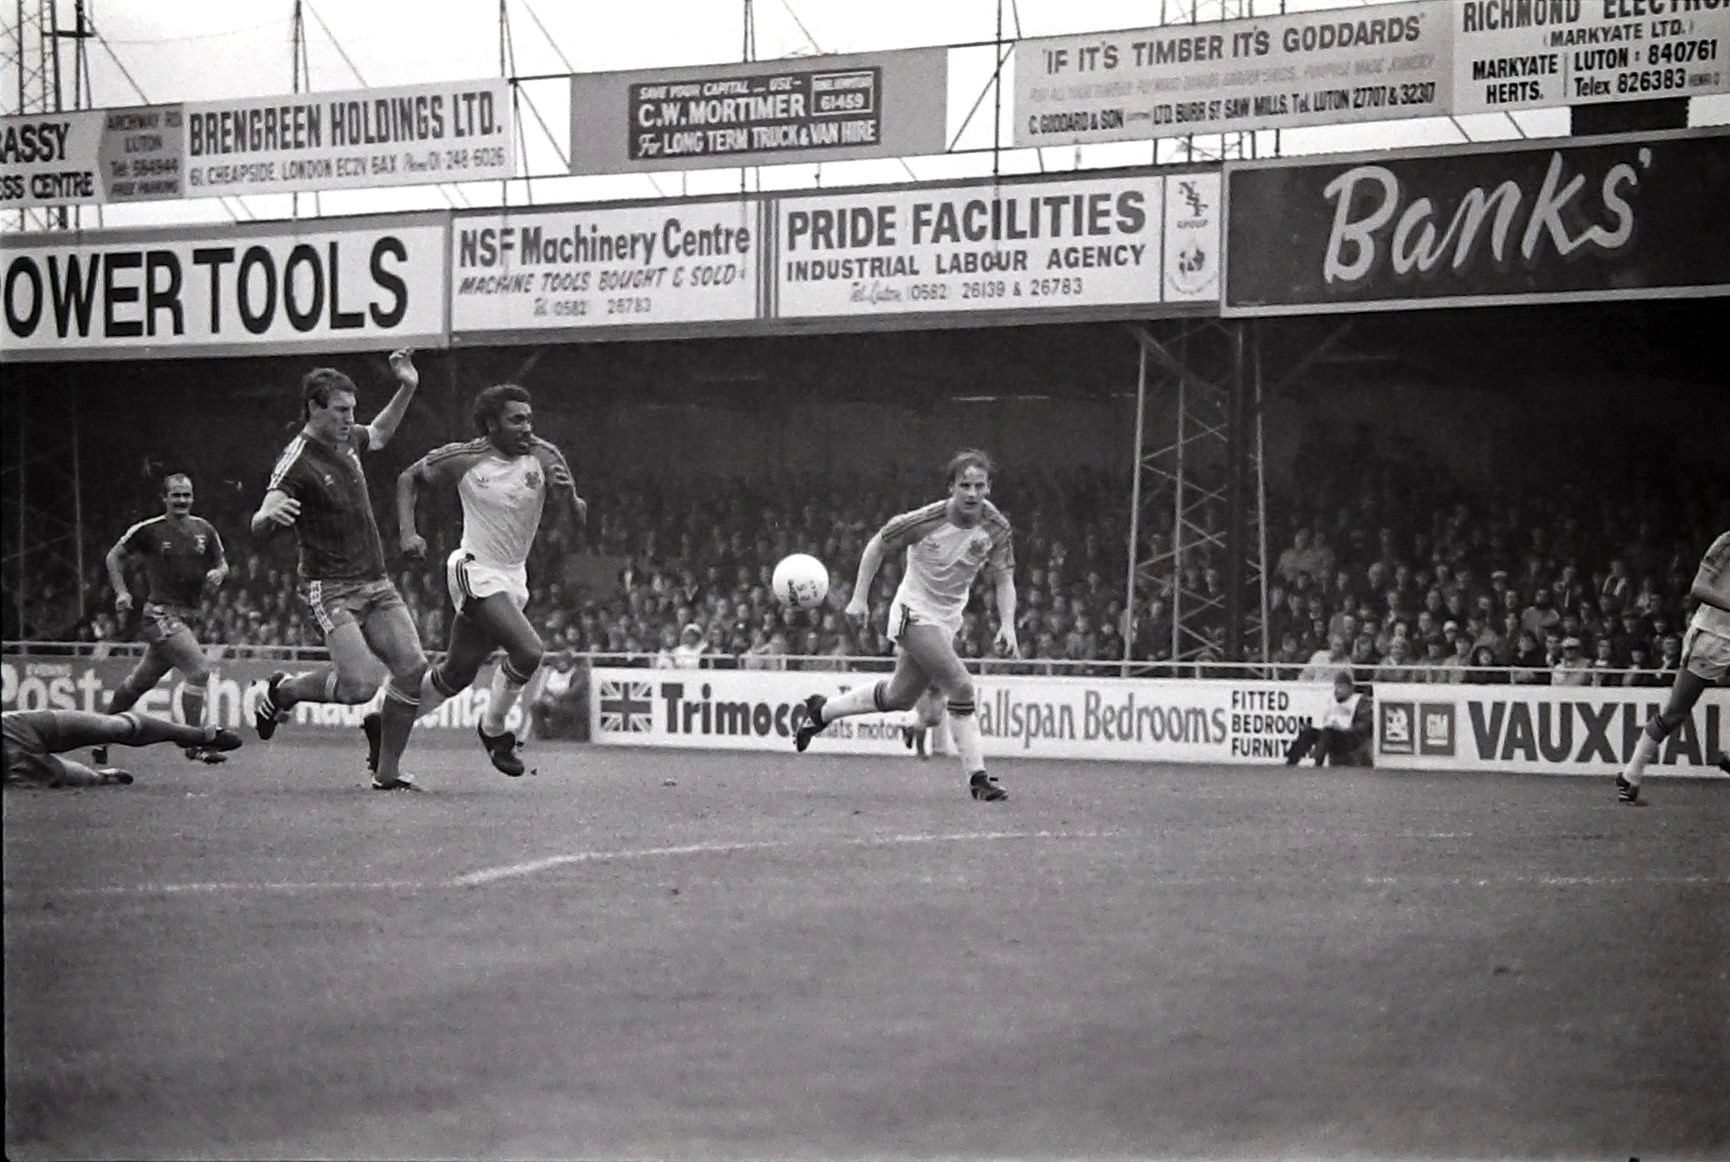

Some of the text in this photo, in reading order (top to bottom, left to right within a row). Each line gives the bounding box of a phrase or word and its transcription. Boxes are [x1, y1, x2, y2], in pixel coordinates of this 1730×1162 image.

[1463, 0, 1730, 32] RICHMOND ELEC
[1078, 41, 1119, 72] IT'S
[1132, 35, 1223, 67] TIMBER
[1232, 27, 1270, 58] IT'S
[1574, 48, 1628, 72] LUTON
[1648, 39, 1718, 66] 840761
[1472, 54, 1558, 81] MARKYATE
[1574, 76, 1611, 97] Telex
[1617, 68, 1686, 94] 826383
[703, 80, 750, 96] CAPITAL
[821, 93, 864, 110] 61459
[1486, 80, 1544, 104] HERTS.
[190, 91, 503, 157] BRENGREEN HOLDINGS LTD.
[1101, 108, 1123, 129] SON
[1224, 98, 1249, 119] SAW
[1313, 89, 1350, 112] LUTON
[0, 122, 71, 164] ASSY
[663, 131, 704, 153] LONG
[706, 128, 749, 151] TERM
[752, 125, 799, 149] TRUCK
[809, 122, 839, 144] VAN
[841, 119, 877, 142] HIRE
[0, 174, 24, 200] SS
[32, 171, 94, 199] CENTRE
[208, 162, 275, 184] CHEAPSIDE
[282, 159, 331, 181] LONDON
[787, 204, 896, 251] PRIDE
[912, 190, 1147, 244] FACILITIES
[460, 218, 751, 268] NSF Machinery Centre
[787, 243, 1146, 282] INDUSTRIAL LABOUR AGENCY
[193, 236, 408, 334] TOOLS
[458, 273, 535, 296] MACHINE
[541, 271, 592, 293] TOOLS
[598, 266, 668, 292] BOUGHT
[690, 263, 737, 287] SOLD
[961, 281, 1006, 299] 26139
[1012, 281, 1022, 297] &
[1030, 277, 1083, 296] 26783
[1232, 690, 1289, 711] FITTED
[977, 688, 1227, 749] allspan Bedrooms
[1232, 737, 1291, 758] FURNIT
